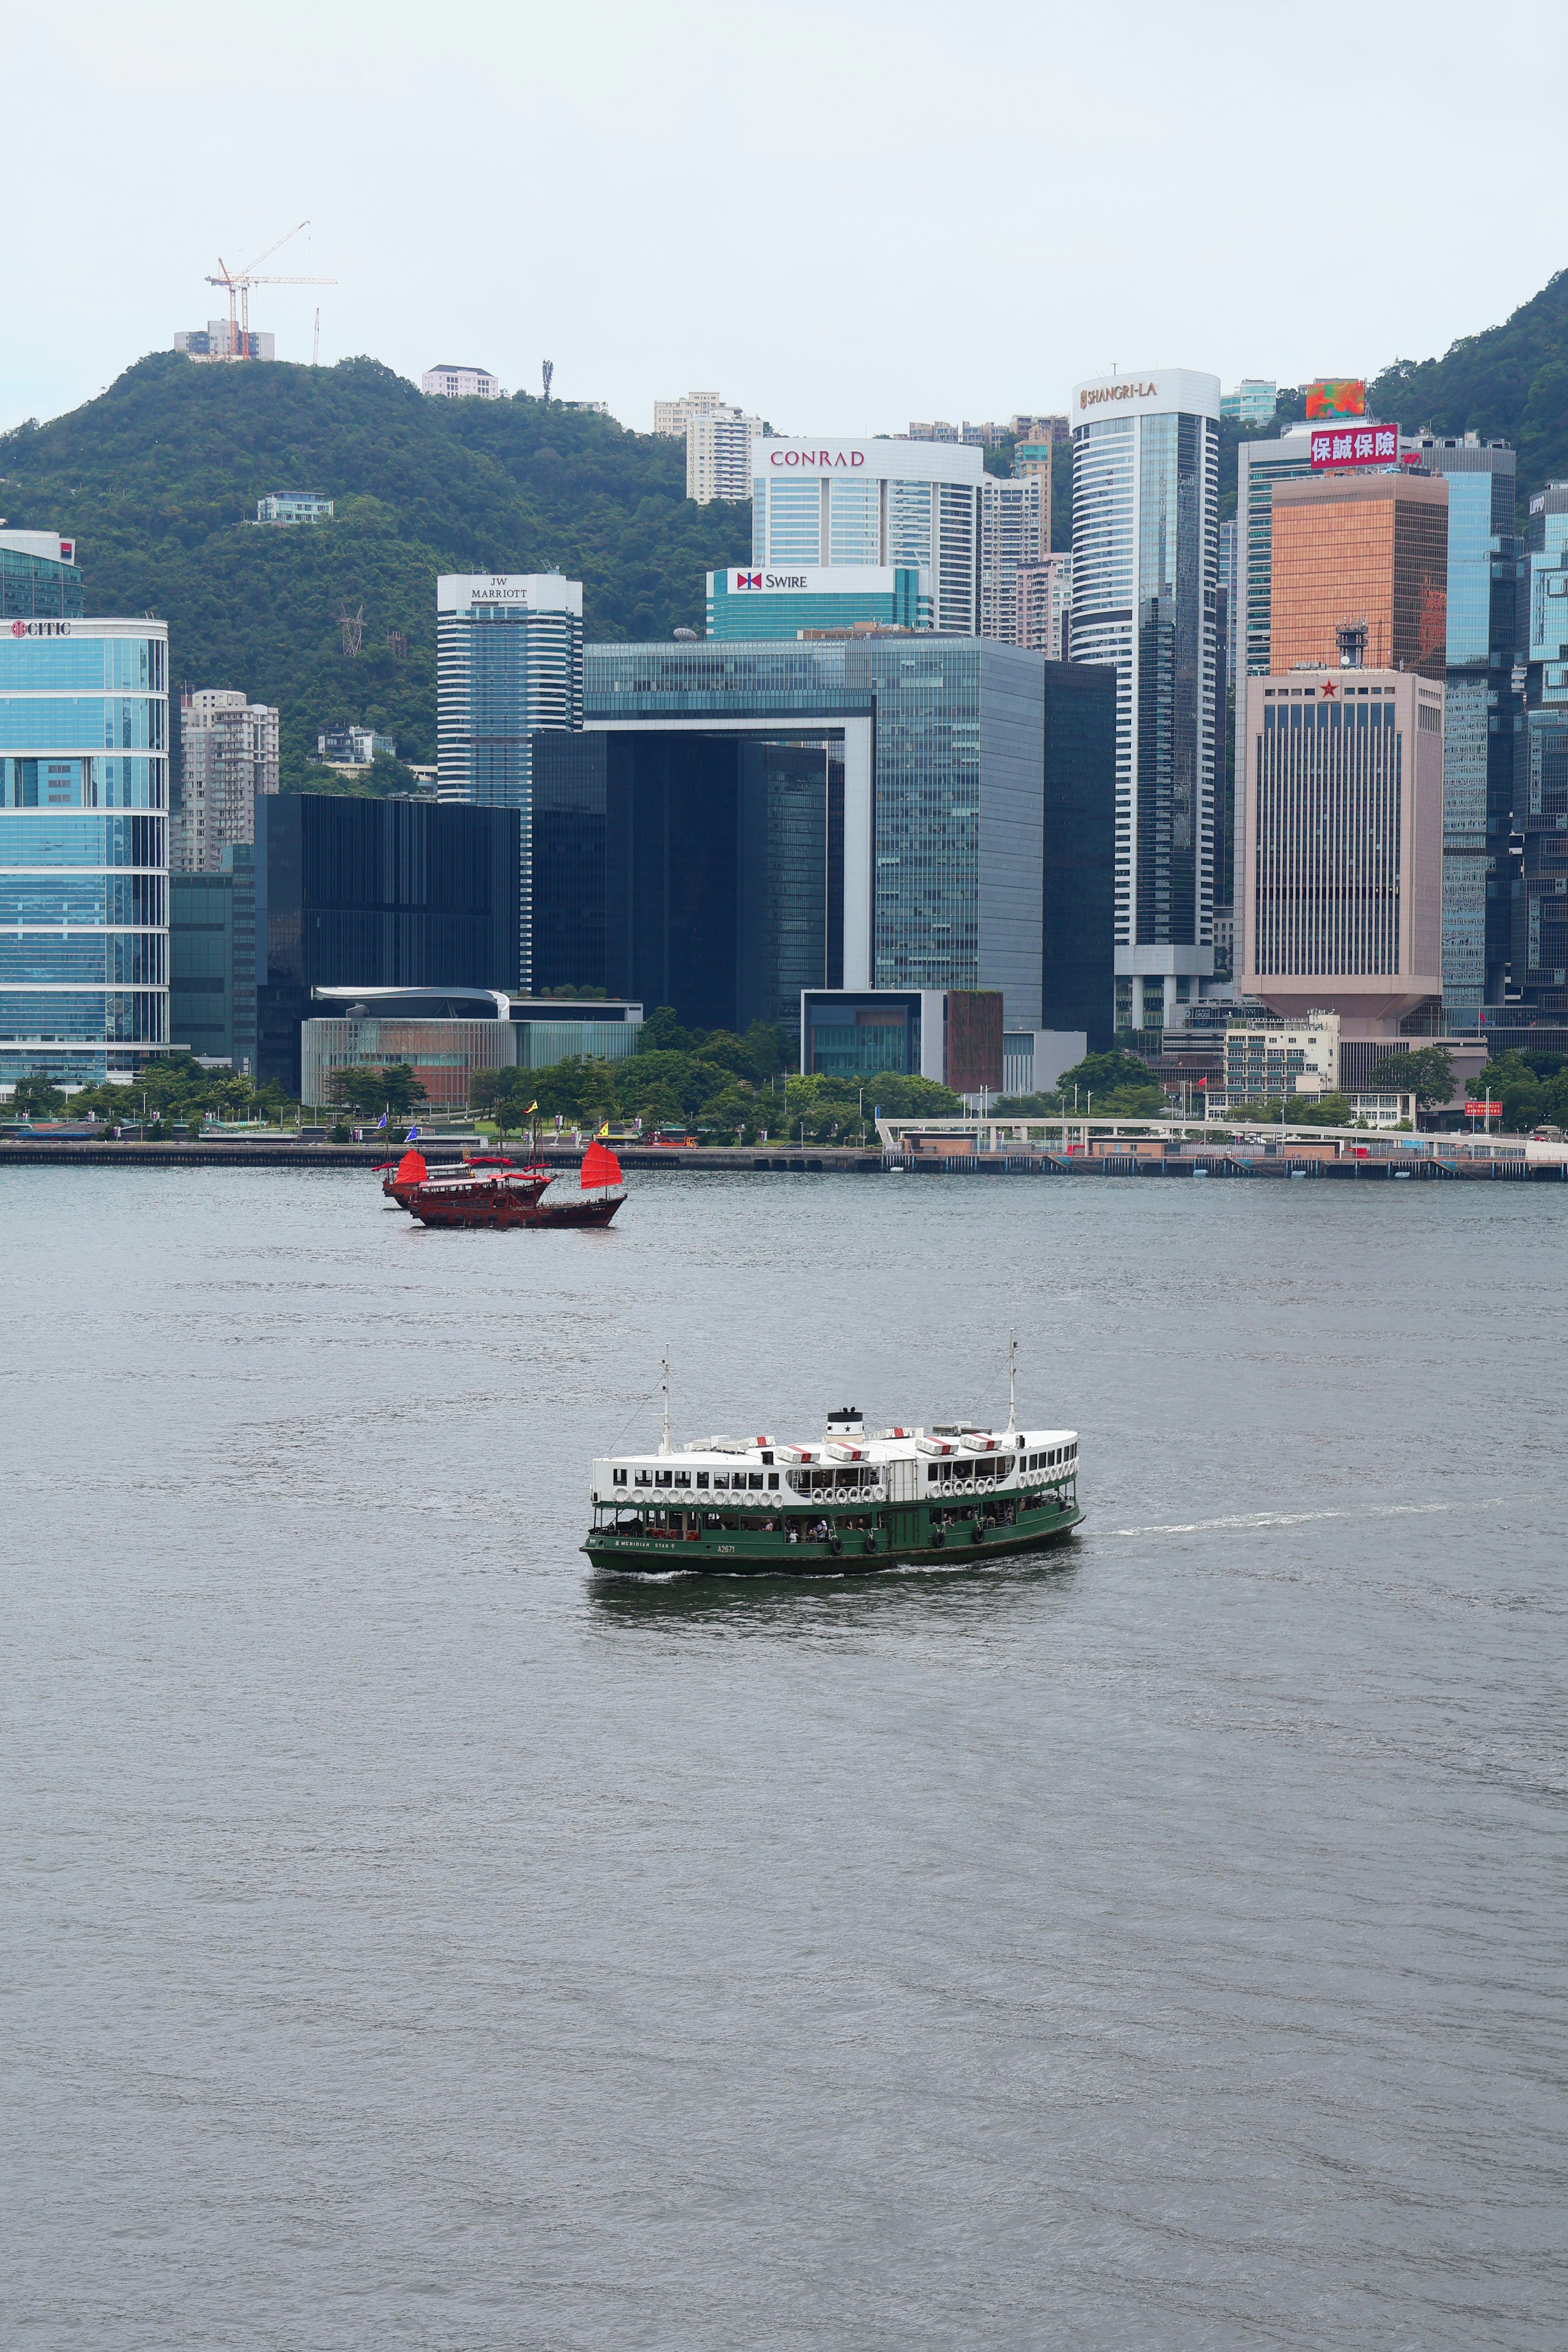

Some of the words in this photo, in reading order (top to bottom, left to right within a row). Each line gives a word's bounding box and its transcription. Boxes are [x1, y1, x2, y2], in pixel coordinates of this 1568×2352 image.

[1087, 382, 1157, 405] SHANGRI-LA
[1312, 431, 1395, 462] 保誠保險
[771, 451, 864, 466] CONRAD
[766, 574, 807, 588] SWIRE
[472, 590, 527, 598] MARRIOTT
[27, 622, 71, 635] CITIC
